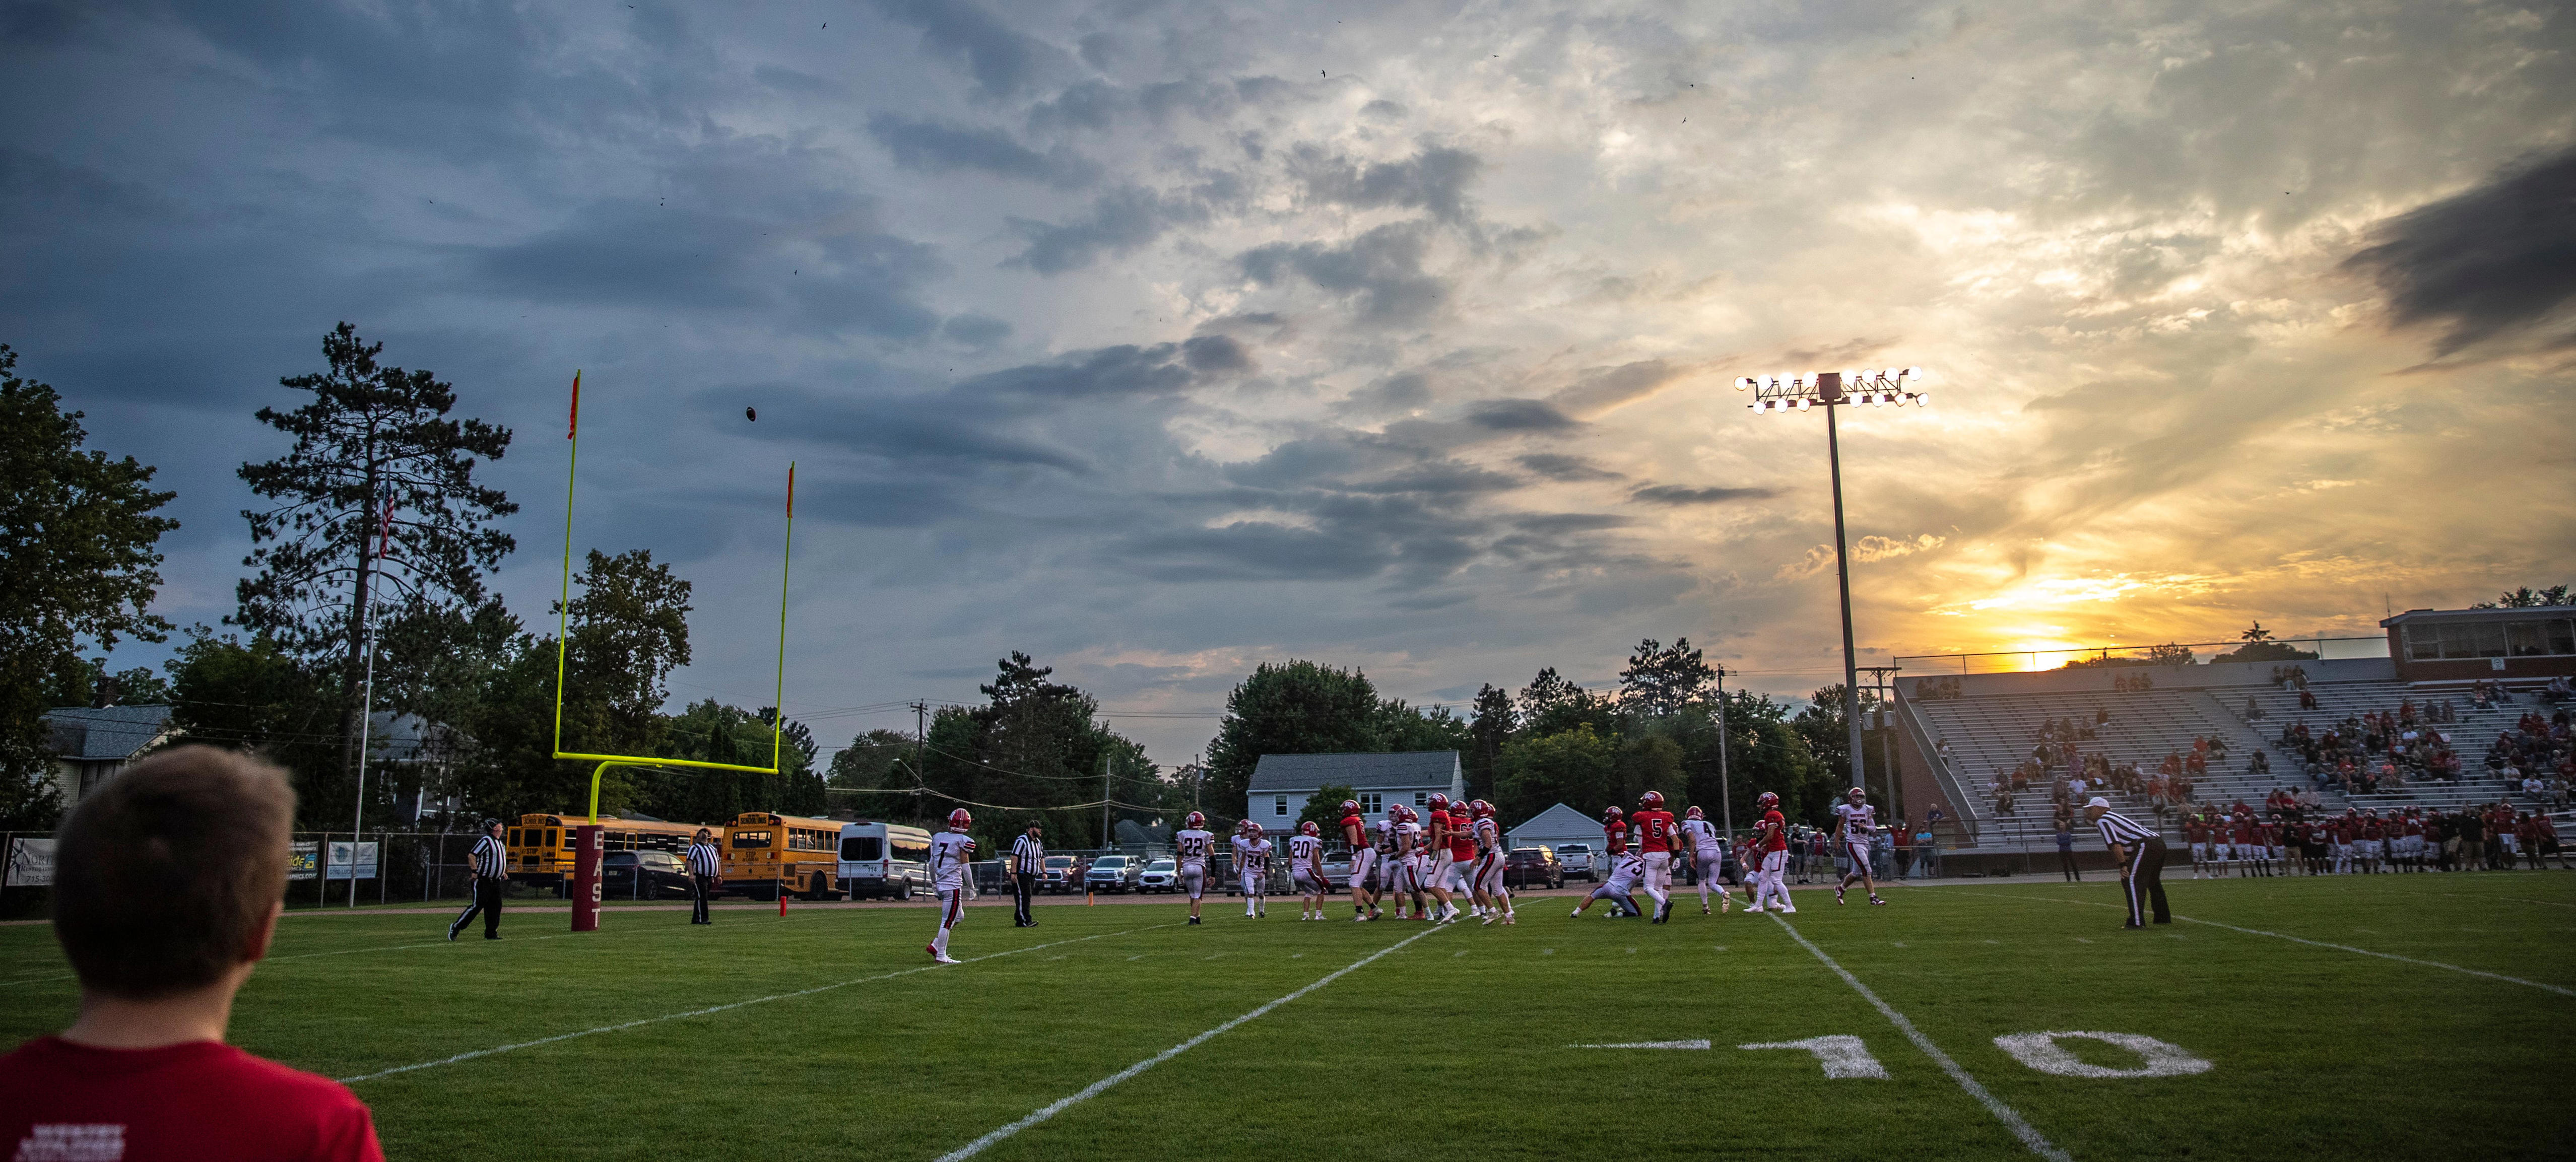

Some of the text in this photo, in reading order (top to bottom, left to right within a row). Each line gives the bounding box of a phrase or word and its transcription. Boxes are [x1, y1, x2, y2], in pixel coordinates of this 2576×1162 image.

[1652, 818, 1663, 838] 5
[1703, 822, 1712, 837] 4
[938, 842, 949, 868] 7
[1184, 838, 1203, 857] 22
[1293, 841, 1310, 859] 20
[22, 852, 53, 865] NORT
[1247, 855, 1261, 868] 24
[1621, 857, 1643, 876] 73
[591, 831, 604, 927] EAST
